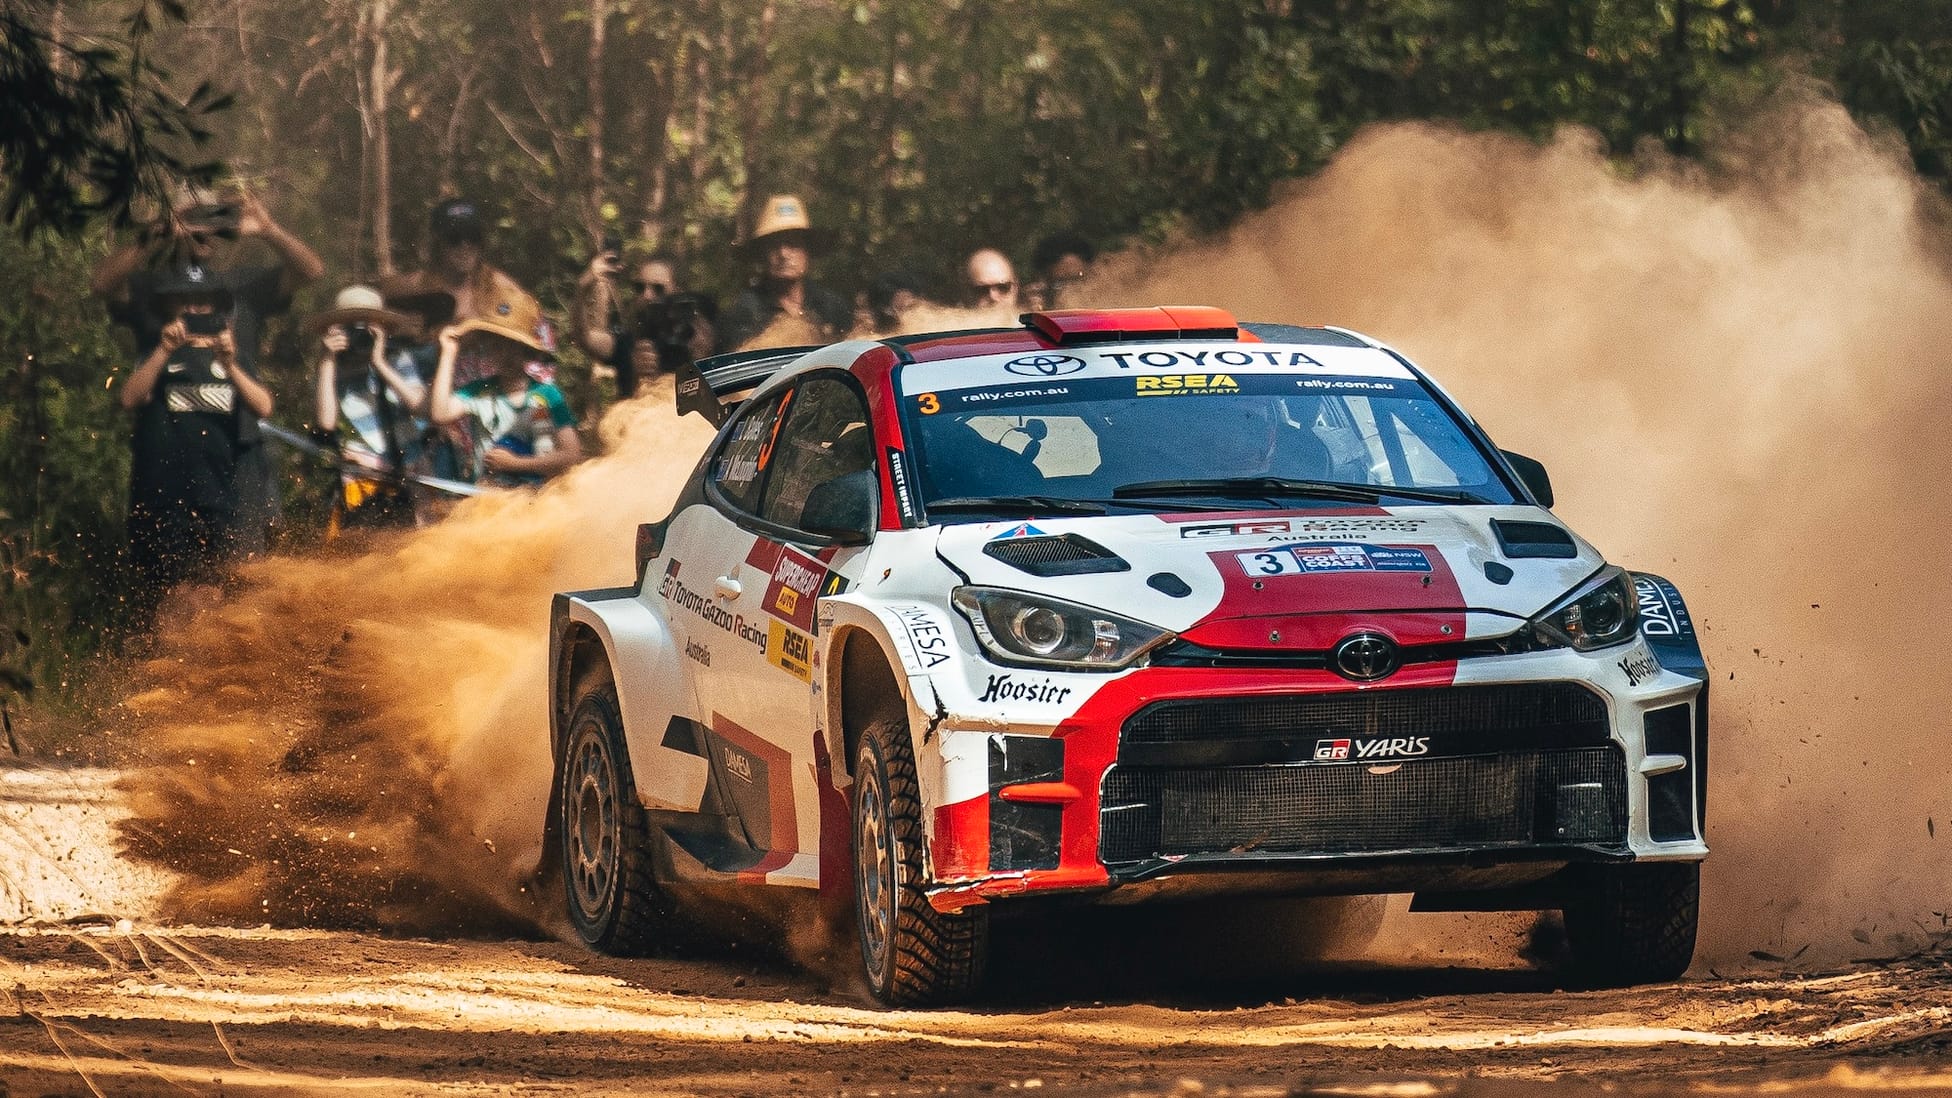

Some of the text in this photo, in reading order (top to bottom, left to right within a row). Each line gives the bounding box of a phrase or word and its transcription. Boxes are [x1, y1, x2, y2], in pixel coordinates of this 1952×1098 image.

[1099, 350, 1324, 369] TOYOTA
[961, 387, 1069, 402] rally.com.au
[1136, 375, 1237, 389] RSEA
[1296, 380, 1394, 391] rally.com.au
[918, 392, 941, 415] 3
[891, 452, 905, 485] STREET
[1266, 533, 1368, 543] Australia
[775, 556, 820, 598] SUPERCHEAP
[1254, 553, 1285, 574] 3
[672, 581, 768, 655] TOYOTA GAZOO Racing
[1634, 578, 1674, 635] DAME
[1658, 582, 1692, 635] INDUST
[685, 636, 711, 667] Australia
[782, 628, 809, 665] RSEA
[978, 673, 1071, 704] Hoosier
